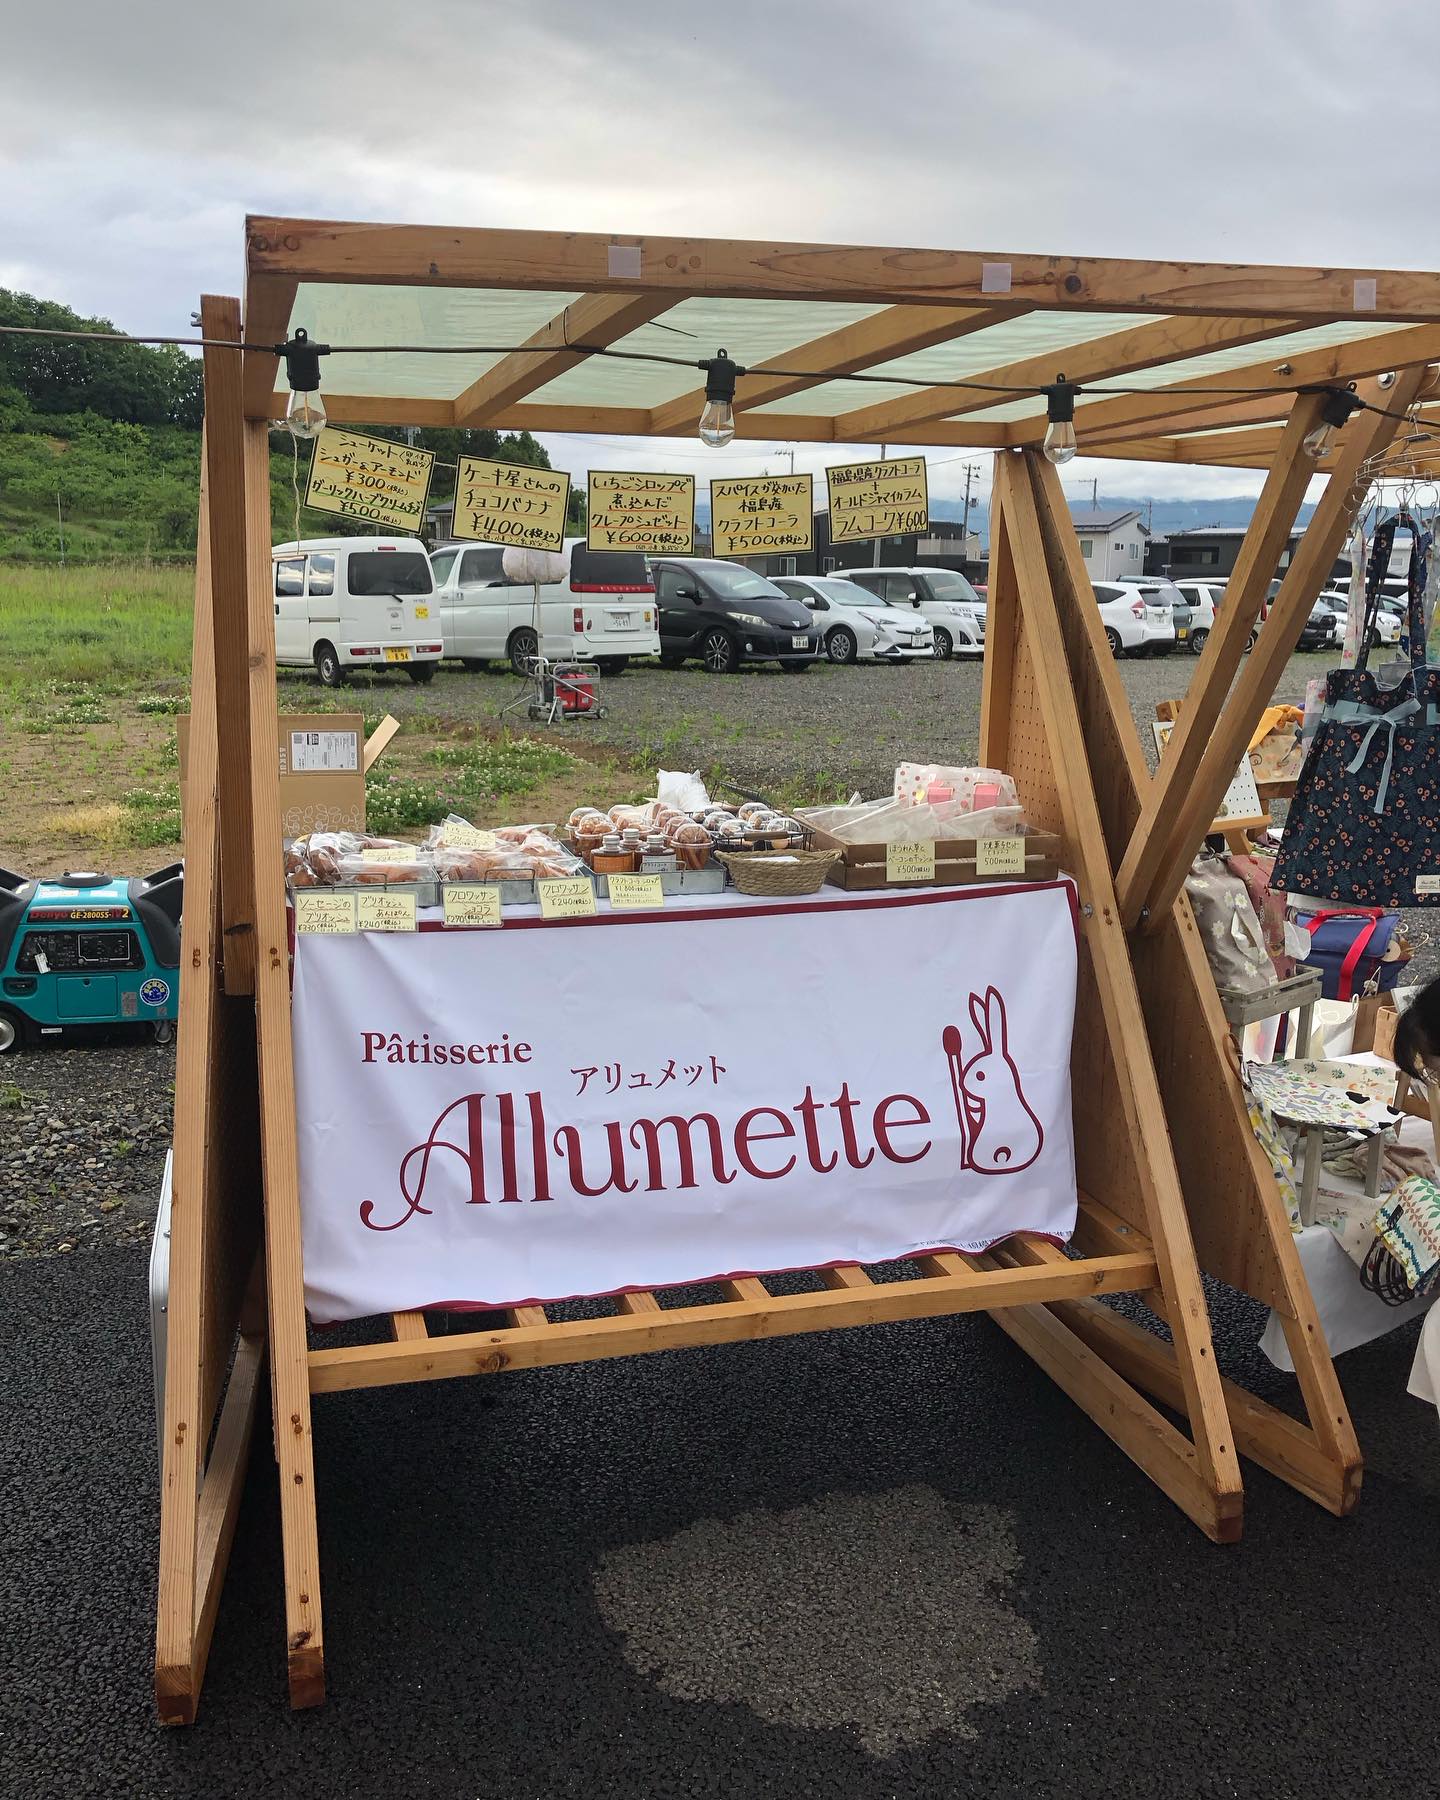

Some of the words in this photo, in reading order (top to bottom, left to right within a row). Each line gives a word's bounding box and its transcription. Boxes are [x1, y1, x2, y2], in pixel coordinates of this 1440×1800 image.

[464, 464, 561, 493] ケーキ屋さんの
[593, 477, 691, 493] いちごシロップで
[463, 489, 552, 515] チョコバナナ
[608, 493, 672, 510] 煮込んだ
[738, 497, 785, 513] 福島産
[718, 514, 798, 533] クラフトコーラ
[448, 891, 496, 902] クロワッサン
[543, 883, 590, 896] クロワッサン
[299, 898, 351, 909] ソーセージの
[361, 1031, 533, 1065] Pâtisserie
[570, 1055, 728, 1097] アリュメット
[359, 1082, 932, 1232] Allumette
